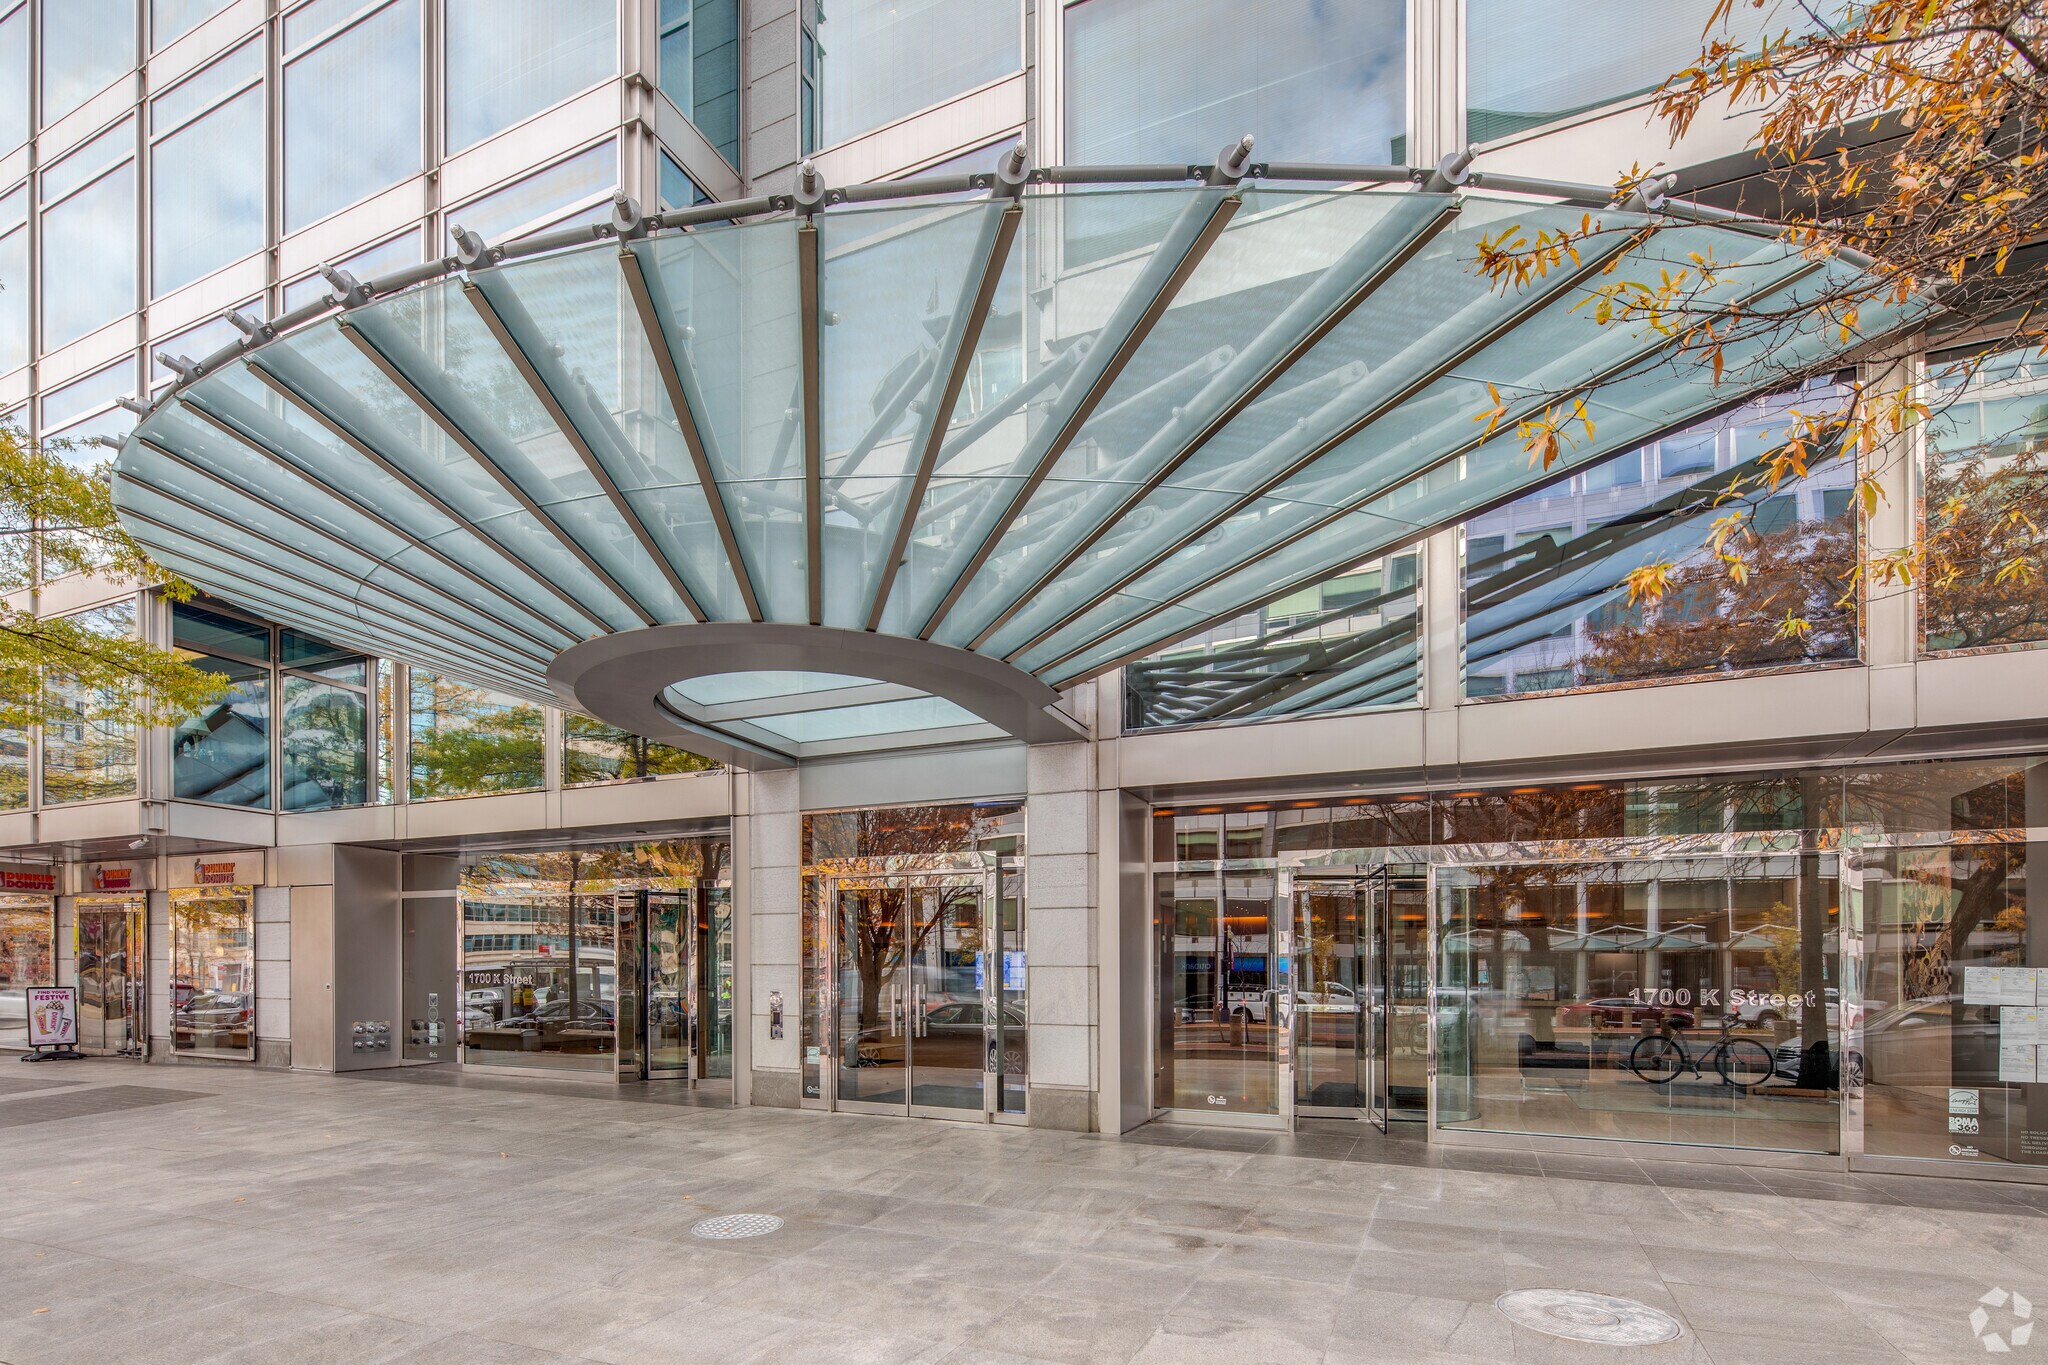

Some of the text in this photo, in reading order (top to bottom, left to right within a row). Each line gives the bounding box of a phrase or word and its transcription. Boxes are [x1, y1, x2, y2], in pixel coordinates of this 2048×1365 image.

[204, 862, 236, 873] DUNKIN'
[6, 871, 56, 882] DUNKIN'
[105, 868, 132, 879] DUNKIN'
[204, 873, 235, 884] DONUTS
[6, 880, 55, 891] DONUTS
[469, 972, 533, 985] 1700 K Street
[1628, 987, 1816, 1008] 1700 K Street
[1949, 1117, 1978, 1125] BOMA
